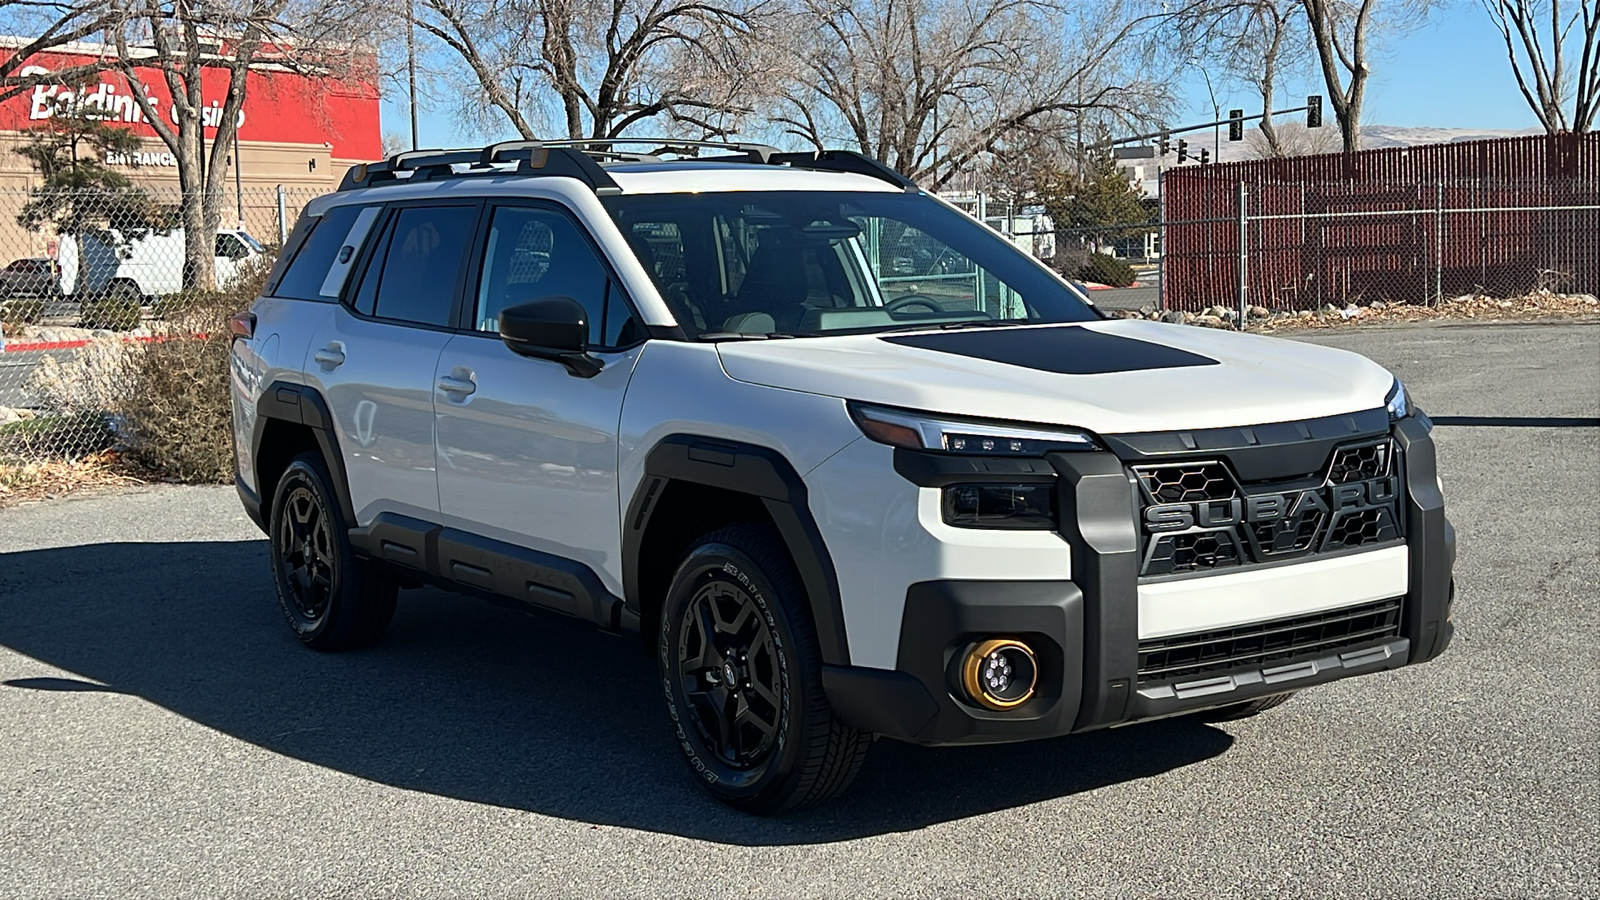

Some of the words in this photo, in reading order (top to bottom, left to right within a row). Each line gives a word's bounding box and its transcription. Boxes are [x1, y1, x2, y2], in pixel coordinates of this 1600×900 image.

[170, 99, 245, 128] Csino
[106, 151, 178, 167] ENTRANCE
[1145, 475, 1398, 532] SUBARU
[723, 561, 791, 751] BRIDGESTONE
[663, 679, 720, 784] DUELER
